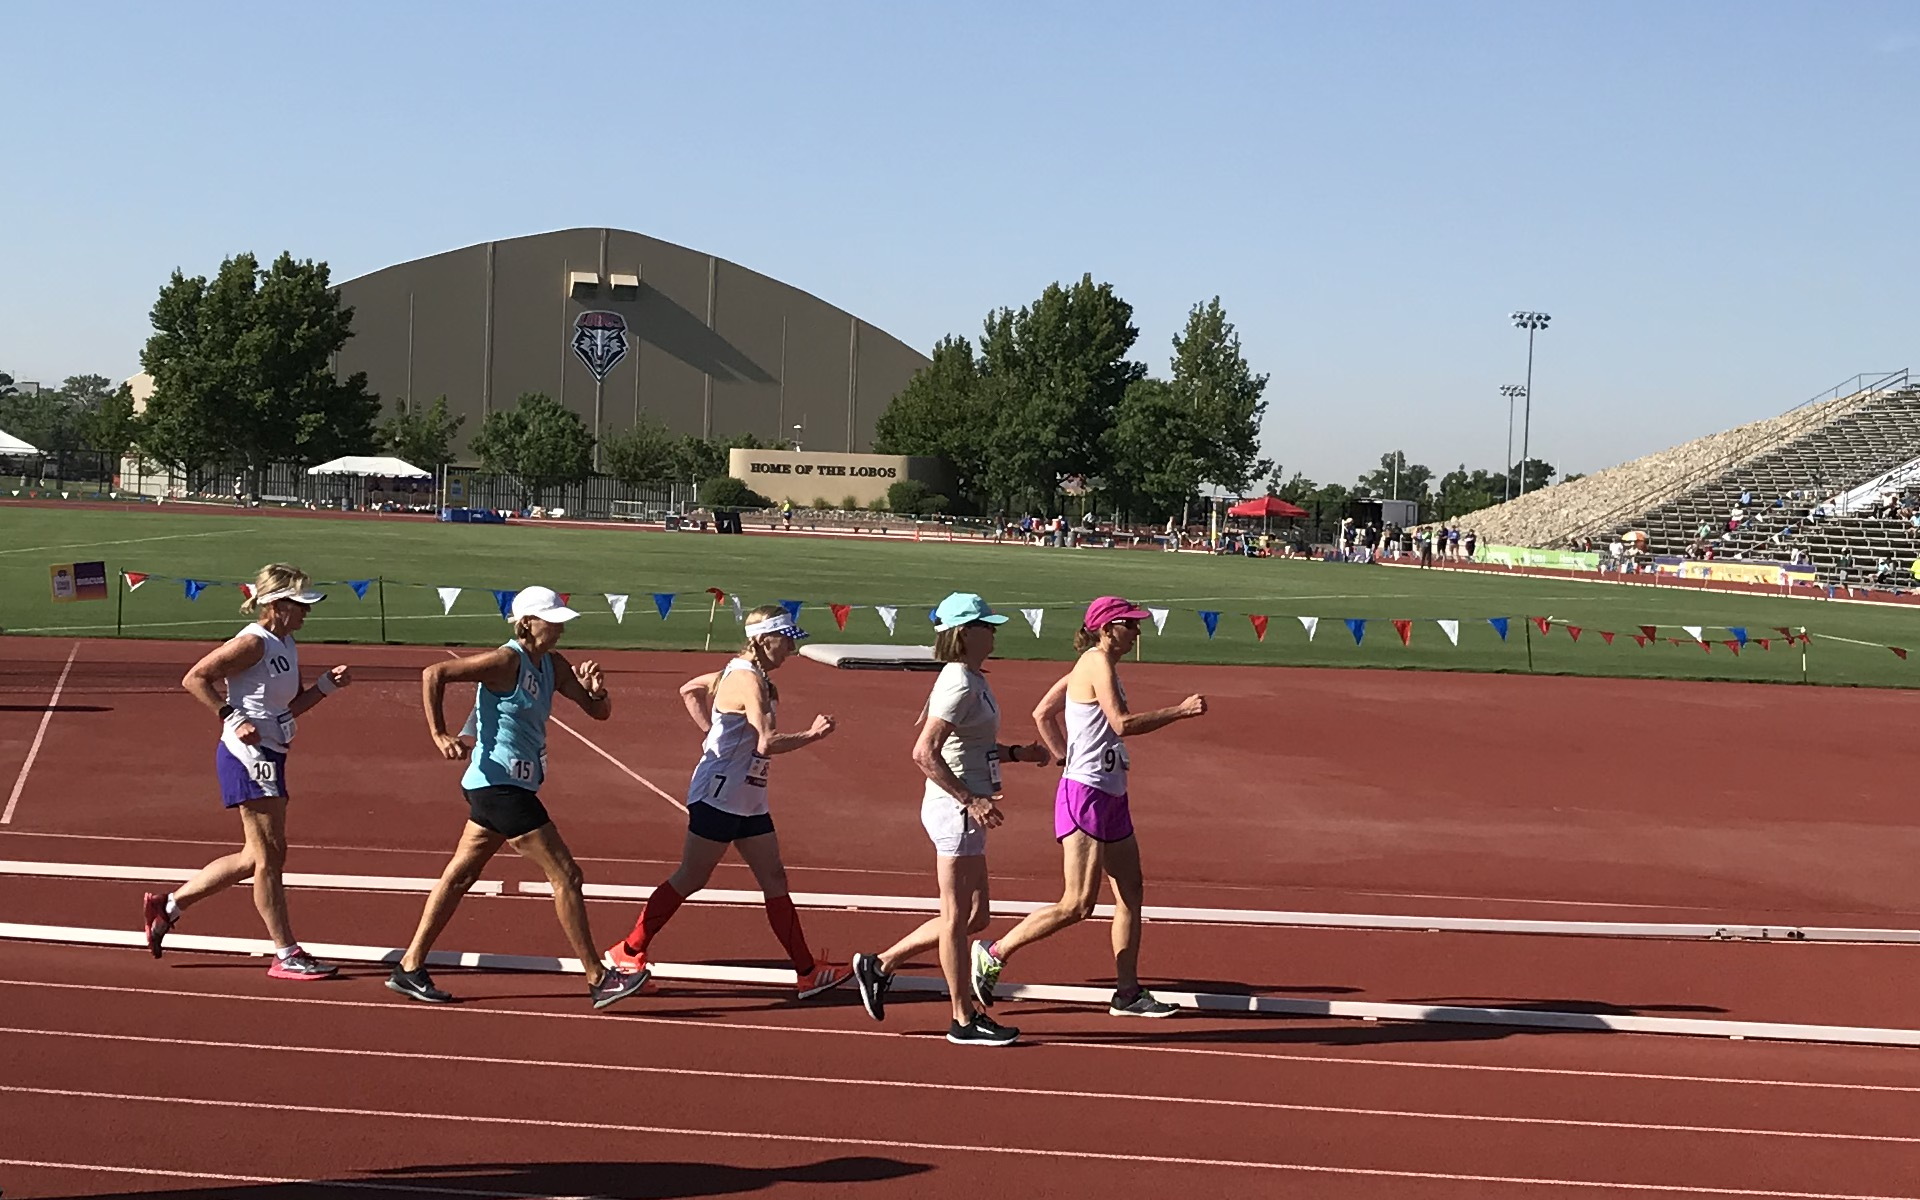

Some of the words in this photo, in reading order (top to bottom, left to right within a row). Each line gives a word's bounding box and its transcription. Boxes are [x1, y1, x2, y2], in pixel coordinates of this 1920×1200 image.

[750, 463, 791, 475] HOME
[795, 465, 813, 475] OF
[817, 466, 846, 476] THE
[849, 467, 897, 478] LOBOS
[270, 655, 290, 674] 10
[515, 760, 531, 780] 15
[1104, 748, 1116, 773] 9
[254, 763, 271, 780] 10
[712, 775, 727, 799] 7
